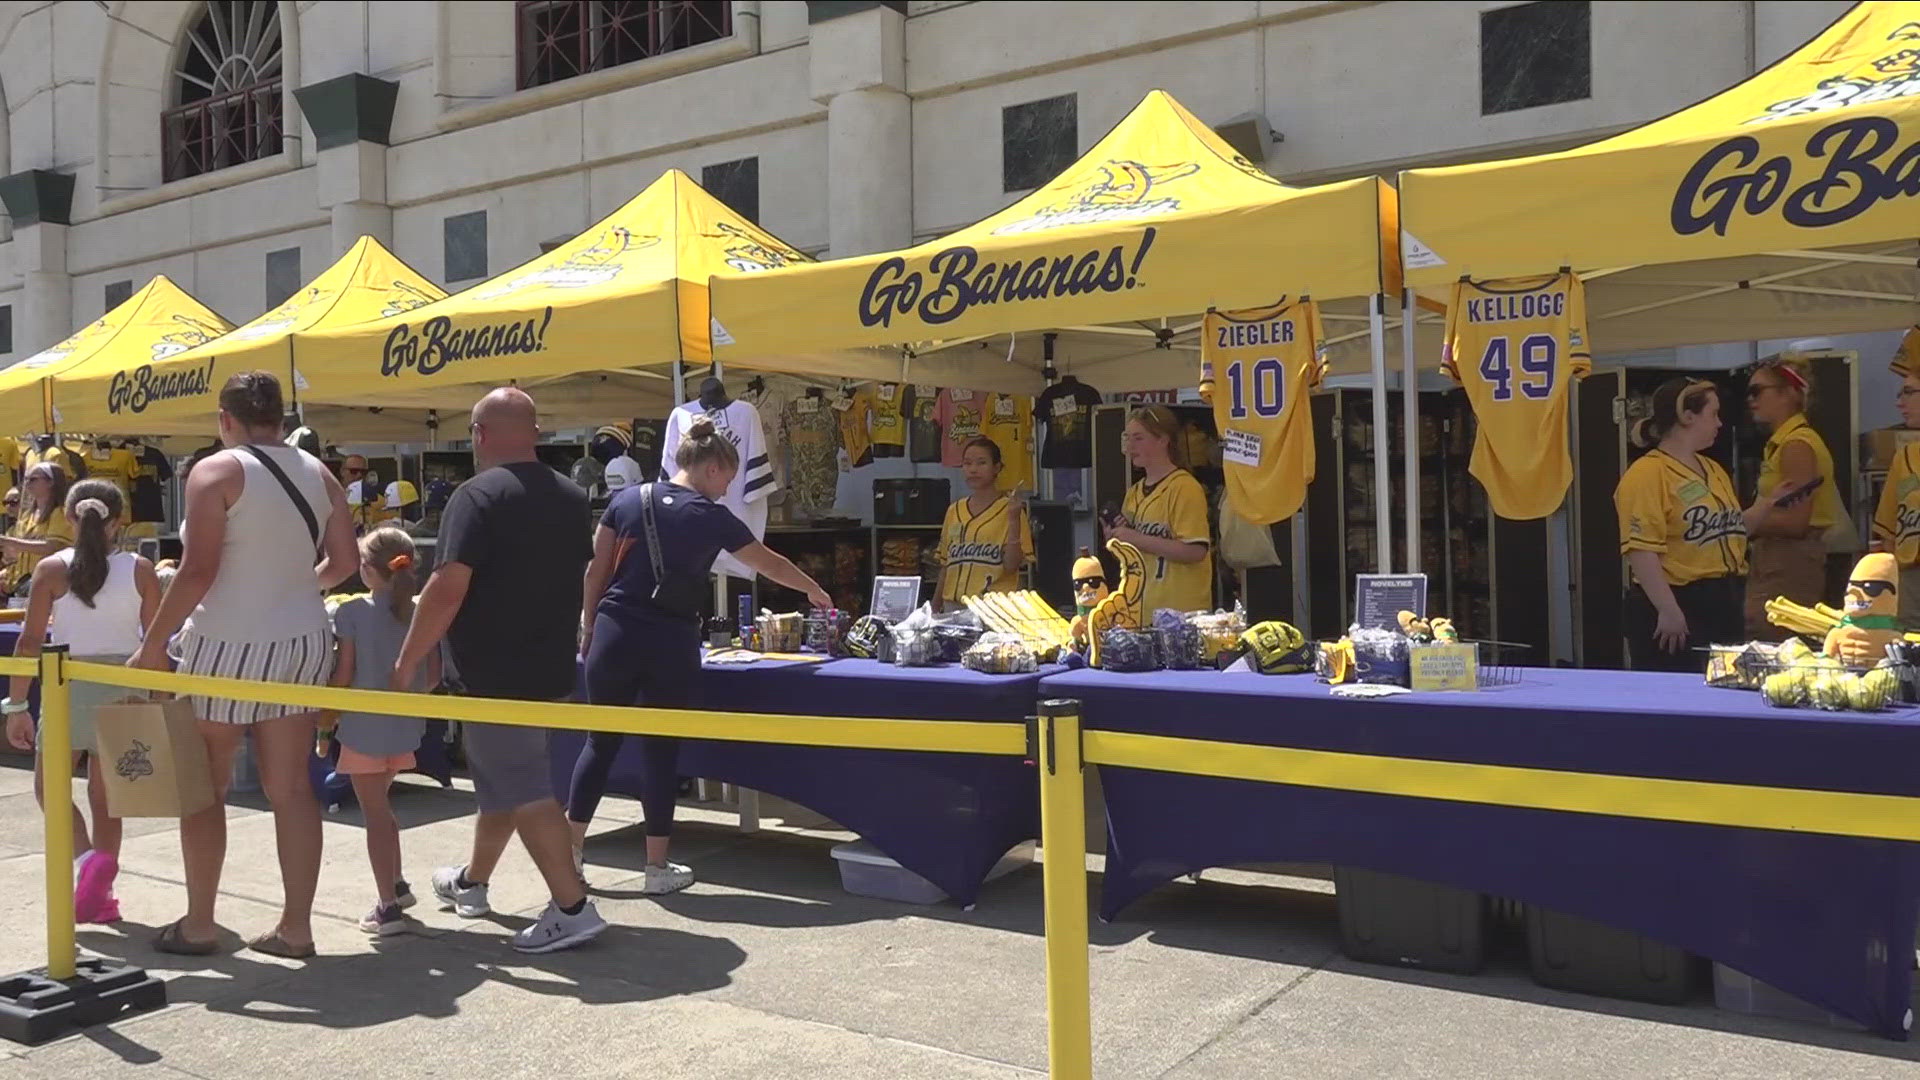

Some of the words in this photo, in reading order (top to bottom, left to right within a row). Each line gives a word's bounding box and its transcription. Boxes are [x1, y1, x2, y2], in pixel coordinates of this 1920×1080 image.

[1671, 136, 1791, 236] Go
[1783, 117, 1920, 228] Ba
[859, 257, 923, 328] Go
[918, 227, 1156, 324] Bananas!
[1218, 320, 1294, 348] ZIEGLER
[1467, 292, 1565, 323] KELLOGG
[381, 324, 417, 377] Go
[417, 305, 552, 375] Bananas!
[1479, 333, 1556, 401] 49
[108, 370, 131, 414] Go
[130, 356, 215, 413] Bananas!
[1226, 358, 1285, 419] 10
[948, 541, 1003, 563] ananas
[1155, 556, 1166, 581] 1
